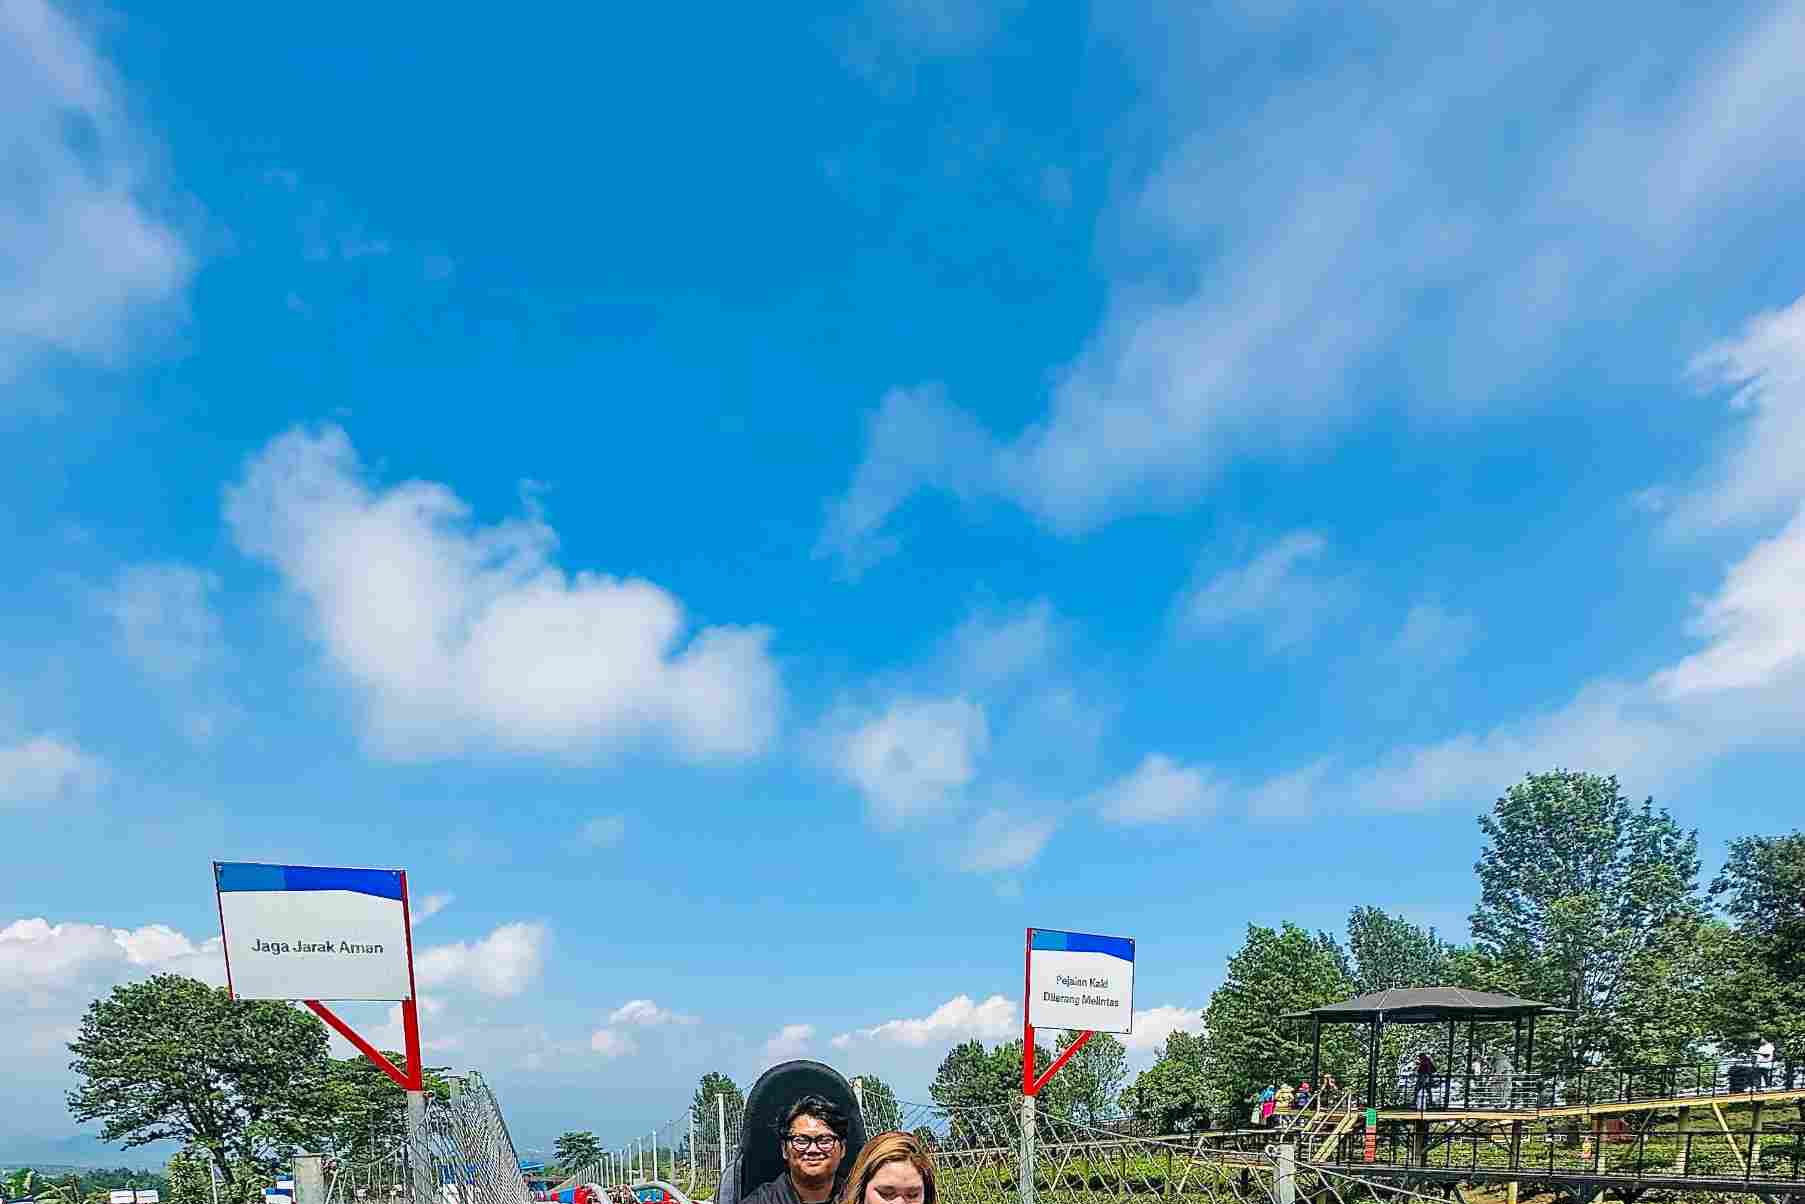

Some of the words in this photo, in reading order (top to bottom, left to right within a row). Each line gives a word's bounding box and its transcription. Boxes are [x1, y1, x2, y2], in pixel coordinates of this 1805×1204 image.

[251, 938, 290, 955] Jaga
[293, 940, 336, 954] Jarak
[339, 940, 384, 954] Aman
